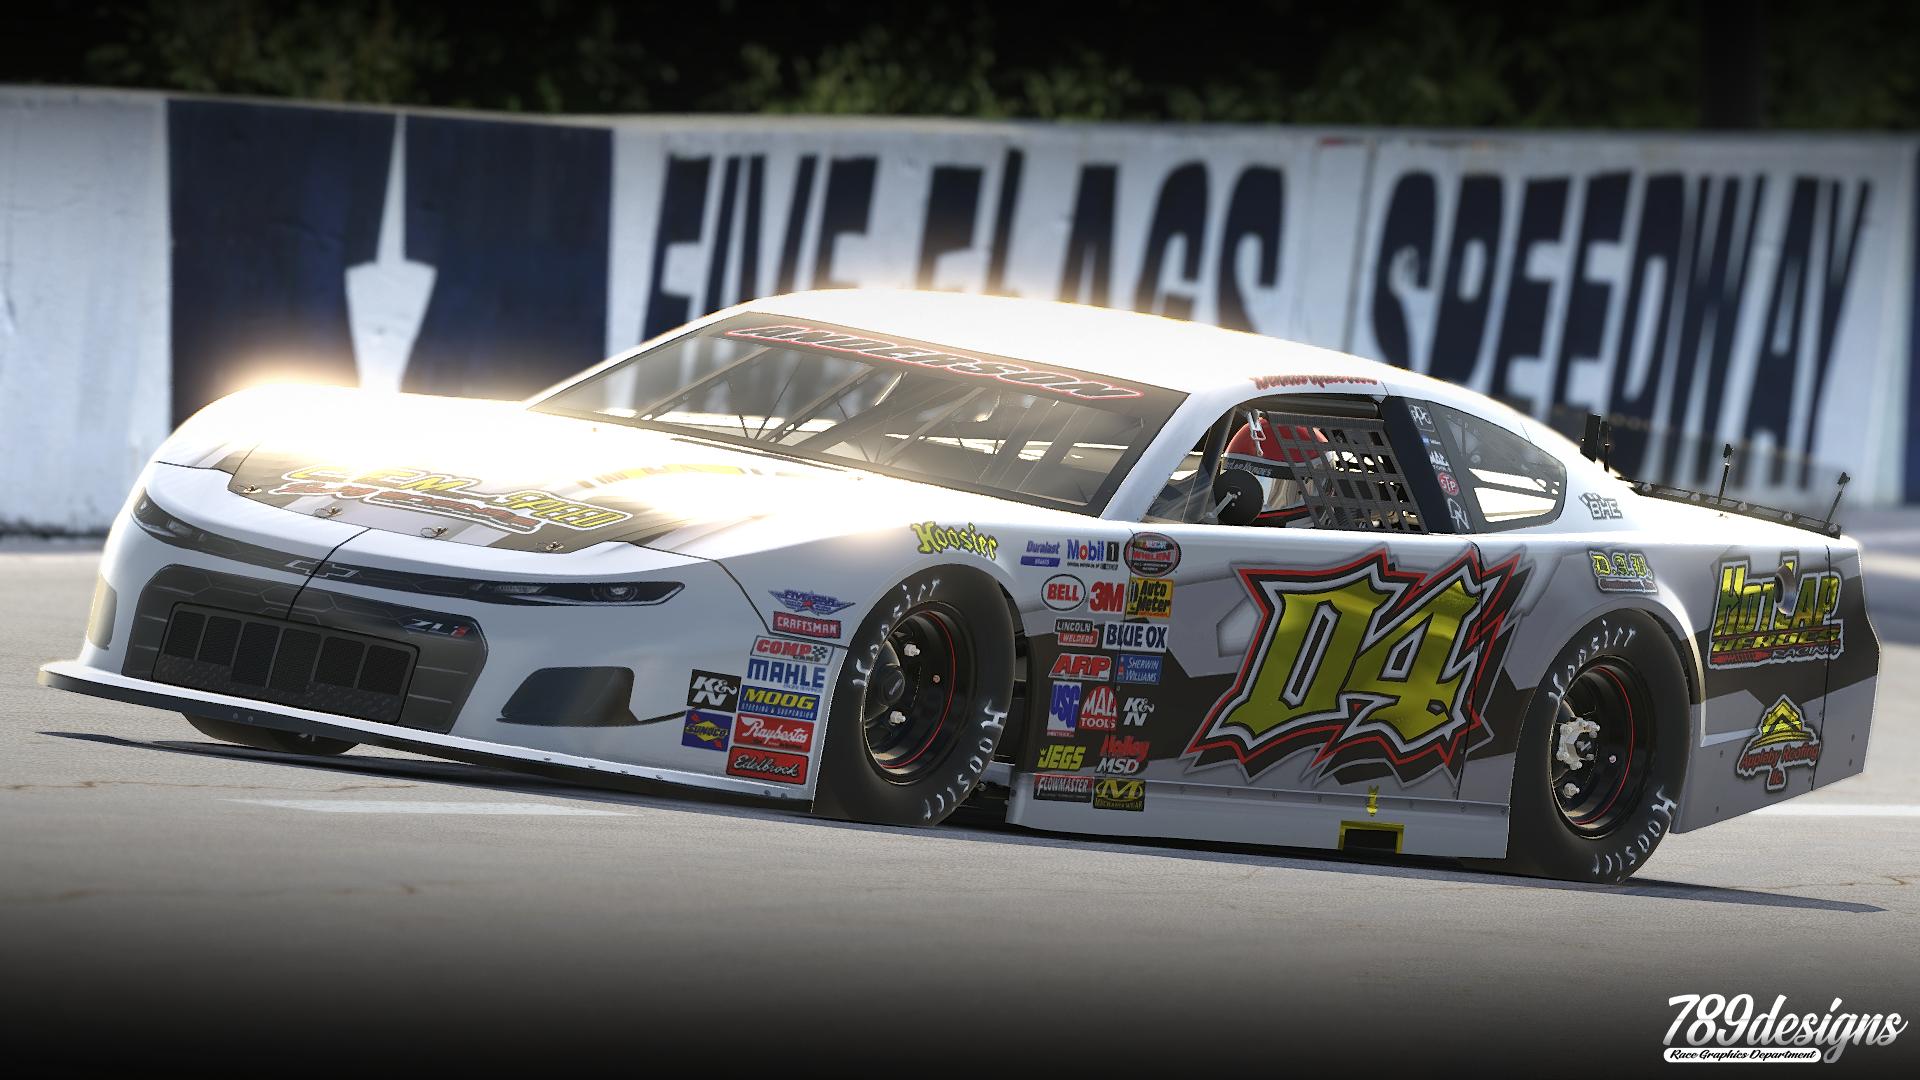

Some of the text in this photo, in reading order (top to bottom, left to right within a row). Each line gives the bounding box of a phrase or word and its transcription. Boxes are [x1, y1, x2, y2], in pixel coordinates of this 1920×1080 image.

[642, 147, 1872, 490] FIVE FLAGS SPEEDWAY
[727, 325, 1143, 399] ANDERSON
[1440, 475, 1457, 492] STP
[911, 521, 998, 561] Hoosier
[1067, 539, 1104, 562] Mobil
[1047, 583, 1079, 602] BELL
[1090, 581, 1125, 612] 3M
[403, 618, 470, 638] ZL1
[777, 616, 837, 633] CRAFTSMAN
[1057, 620, 1091, 633] LINCOLN
[1106, 623, 1168, 648] BLUE OX
[756, 639, 812, 656] COMP
[1062, 633, 1094, 643] WELDERS
[747, 658, 826, 689] MAHLE
[1053, 655, 1111, 678] ARP
[744, 688, 816, 710] MOOG
[1082, 688, 1118, 717] MAC
[685, 723, 728, 738] SUNOCO
[740, 716, 809, 744] Raybestos
[1080, 717, 1116, 729] TOOLS
[1037, 744, 1086, 770] JEGS
[1100, 735, 1151, 763] Holley
[733, 754, 800, 777] Edelbrock
[1096, 757, 1140, 774] MSD
[1037, 778, 1089, 796] FLOWMASTER
